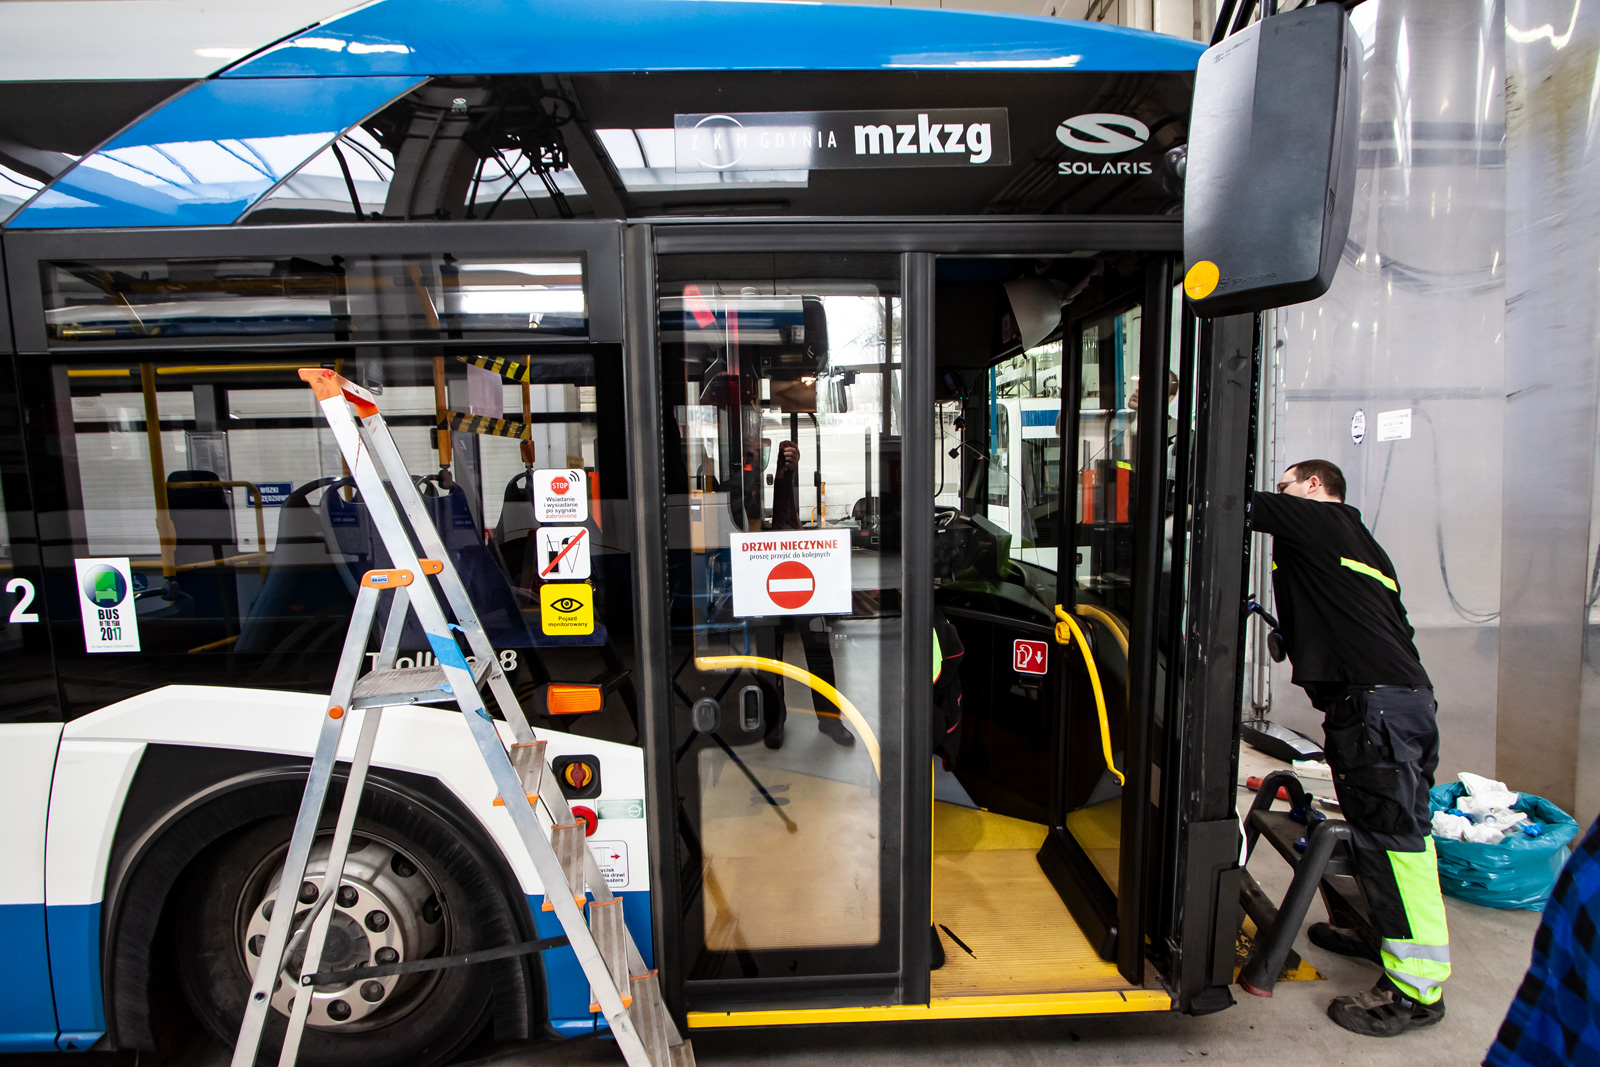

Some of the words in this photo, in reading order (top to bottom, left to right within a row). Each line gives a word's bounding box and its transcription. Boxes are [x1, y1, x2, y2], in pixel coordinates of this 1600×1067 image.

[760, 131, 837, 149] GDYNIA
[854, 113, 992, 163] mzkzg
[1057, 161, 1153, 175] SOLARIS
[551, 482, 569, 490] STOP
[741, 542, 777, 552] DRZWI
[780, 539, 838, 550] NIECZYNNE
[749, 553, 769, 561] proszę
[770, 552, 791, 560] przejść
[801, 551, 831, 559] kolejnych
[5, 577, 40, 623] 2
[98, 608, 120, 620] BUS
[100, 627, 121, 641] 2017
